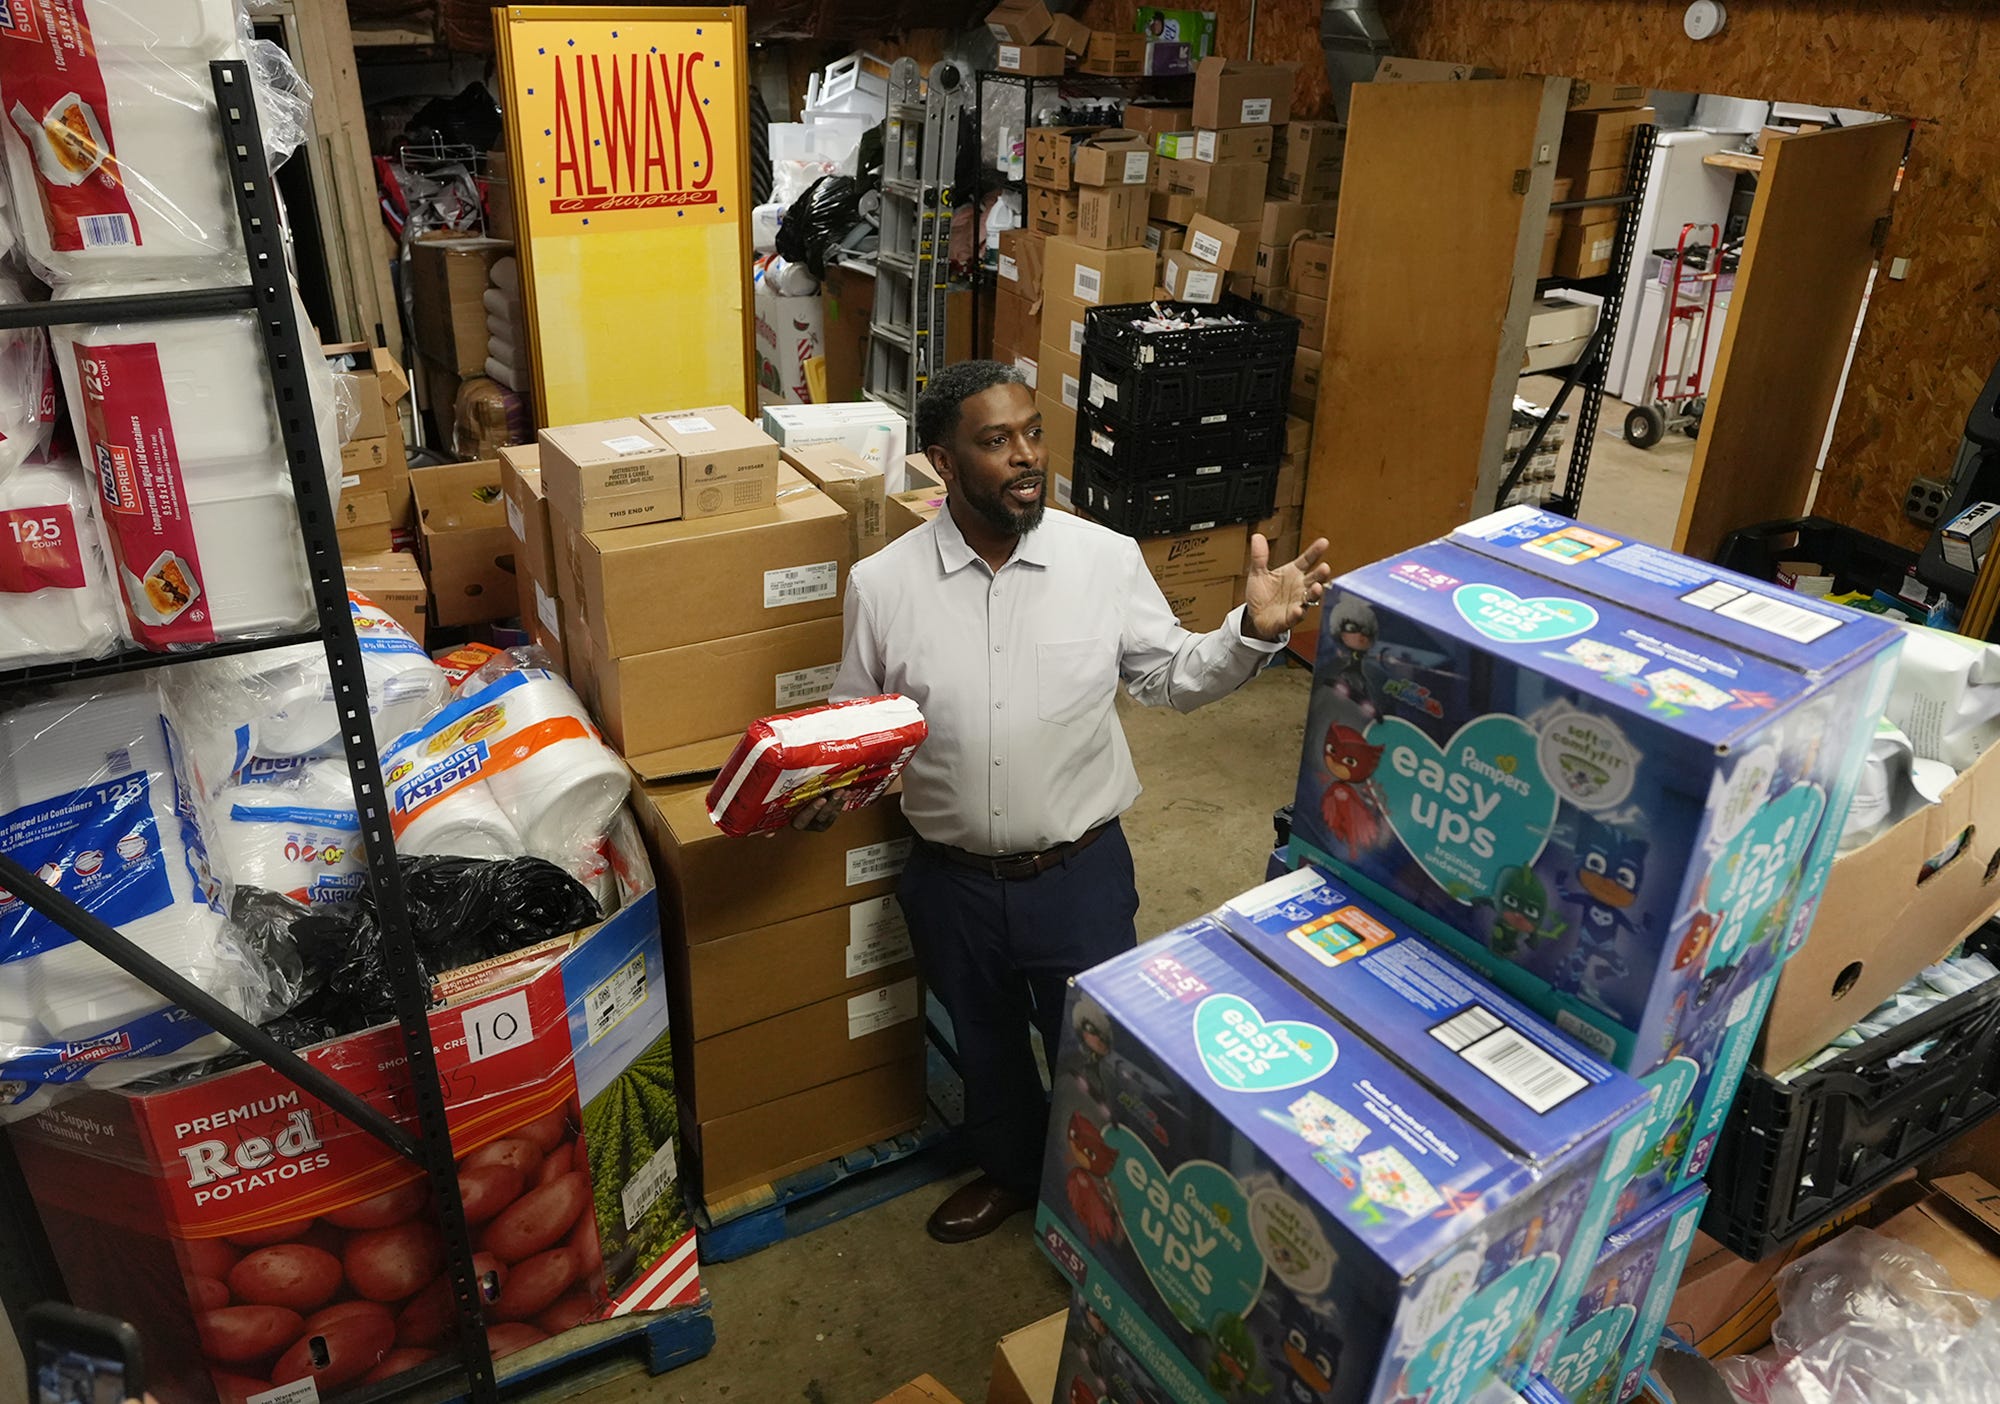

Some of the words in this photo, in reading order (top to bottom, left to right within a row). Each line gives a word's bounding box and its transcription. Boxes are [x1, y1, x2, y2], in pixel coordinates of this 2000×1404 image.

[555, 52, 714, 197] ALWAYS
[559, 197, 585, 210] a
[594, 191, 711, 209] surprise
[83, 359, 104, 401] 125
[100, 360, 111, 387] COUNT
[131, 416, 146, 454] Containers
[97, 446, 119, 504] Hefty
[113, 453, 136, 509] SUPREME
[8, 517, 61, 543] 125
[609, 509, 627, 518] THIS
[627, 507, 643, 516] END
[644, 505, 655, 513] UP
[32, 538, 62, 549] COUNT
[1478, 592, 1553, 623] easy
[1478, 605, 1540, 633] ups
[1568, 725, 1598, 744] soft
[401, 744, 479, 793] SUPREME
[407, 759, 478, 807] Hefty
[1392, 746, 1501, 822] easy
[1461, 746, 1531, 797] Pampers
[37, 812, 49, 824] Lid
[50, 800, 93, 819] Containers
[1411, 793, 1497, 859] ups
[1424, 852, 1488, 891] underwear
[1434, 846, 1481, 879] training
[445, 953, 519, 980] PARCHMENT
[522, 941, 557, 956] PAPER
[433, 1046, 441, 1054] &
[443, 1037, 467, 1051] CRE
[475, 1012, 518, 1056] 10
[1215, 1030, 1271, 1076] ups
[1221, 1009, 1289, 1060] easy
[36, 1117, 83, 1142] Vitamin
[83, 1132, 93, 1145] C
[60, 1110, 101, 1135] Supply
[102, 1124, 115, 1137] of
[174, 1090, 299, 1139] PREMIUM
[178, 1107, 324, 1188] Red
[194, 1153, 331, 1206] POTATOES
[1125, 1157, 1218, 1259] easy
[1183, 1182, 1243, 1252] Pampers
[1140, 1207, 1214, 1297] ups
[274, 1386, 312, 1402] Warehouse
